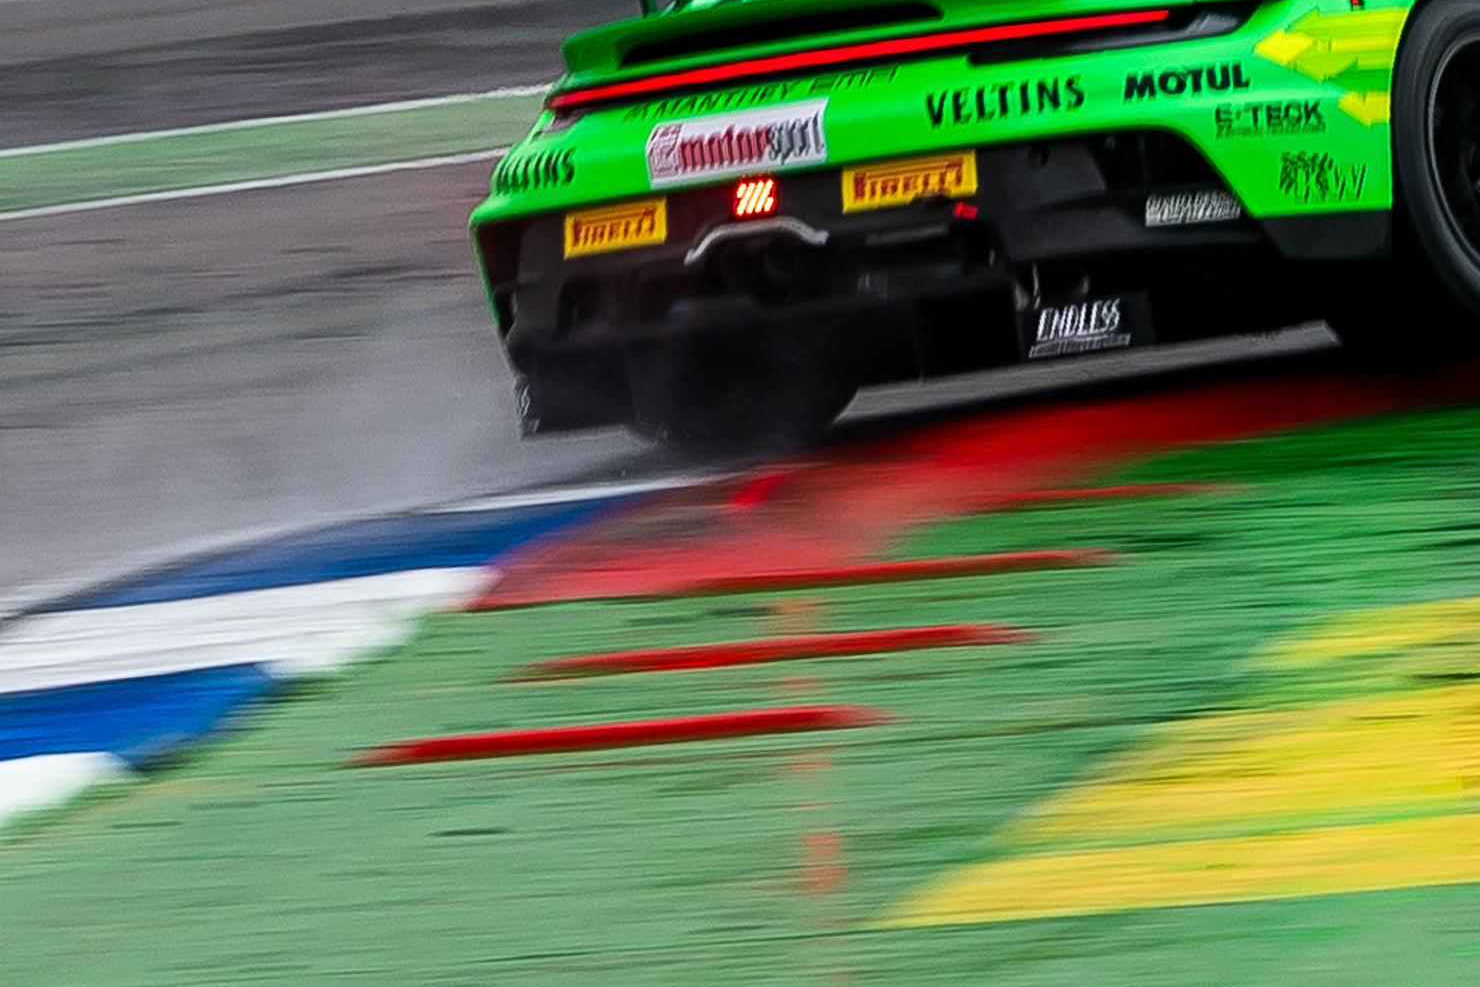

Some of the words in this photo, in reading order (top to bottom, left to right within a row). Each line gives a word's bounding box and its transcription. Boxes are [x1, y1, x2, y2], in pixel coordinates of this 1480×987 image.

[926, 74, 1085, 128] VELTINS
[1123, 60, 1250, 102] MOTUL
[1036, 298, 1121, 341] ENDLESS
